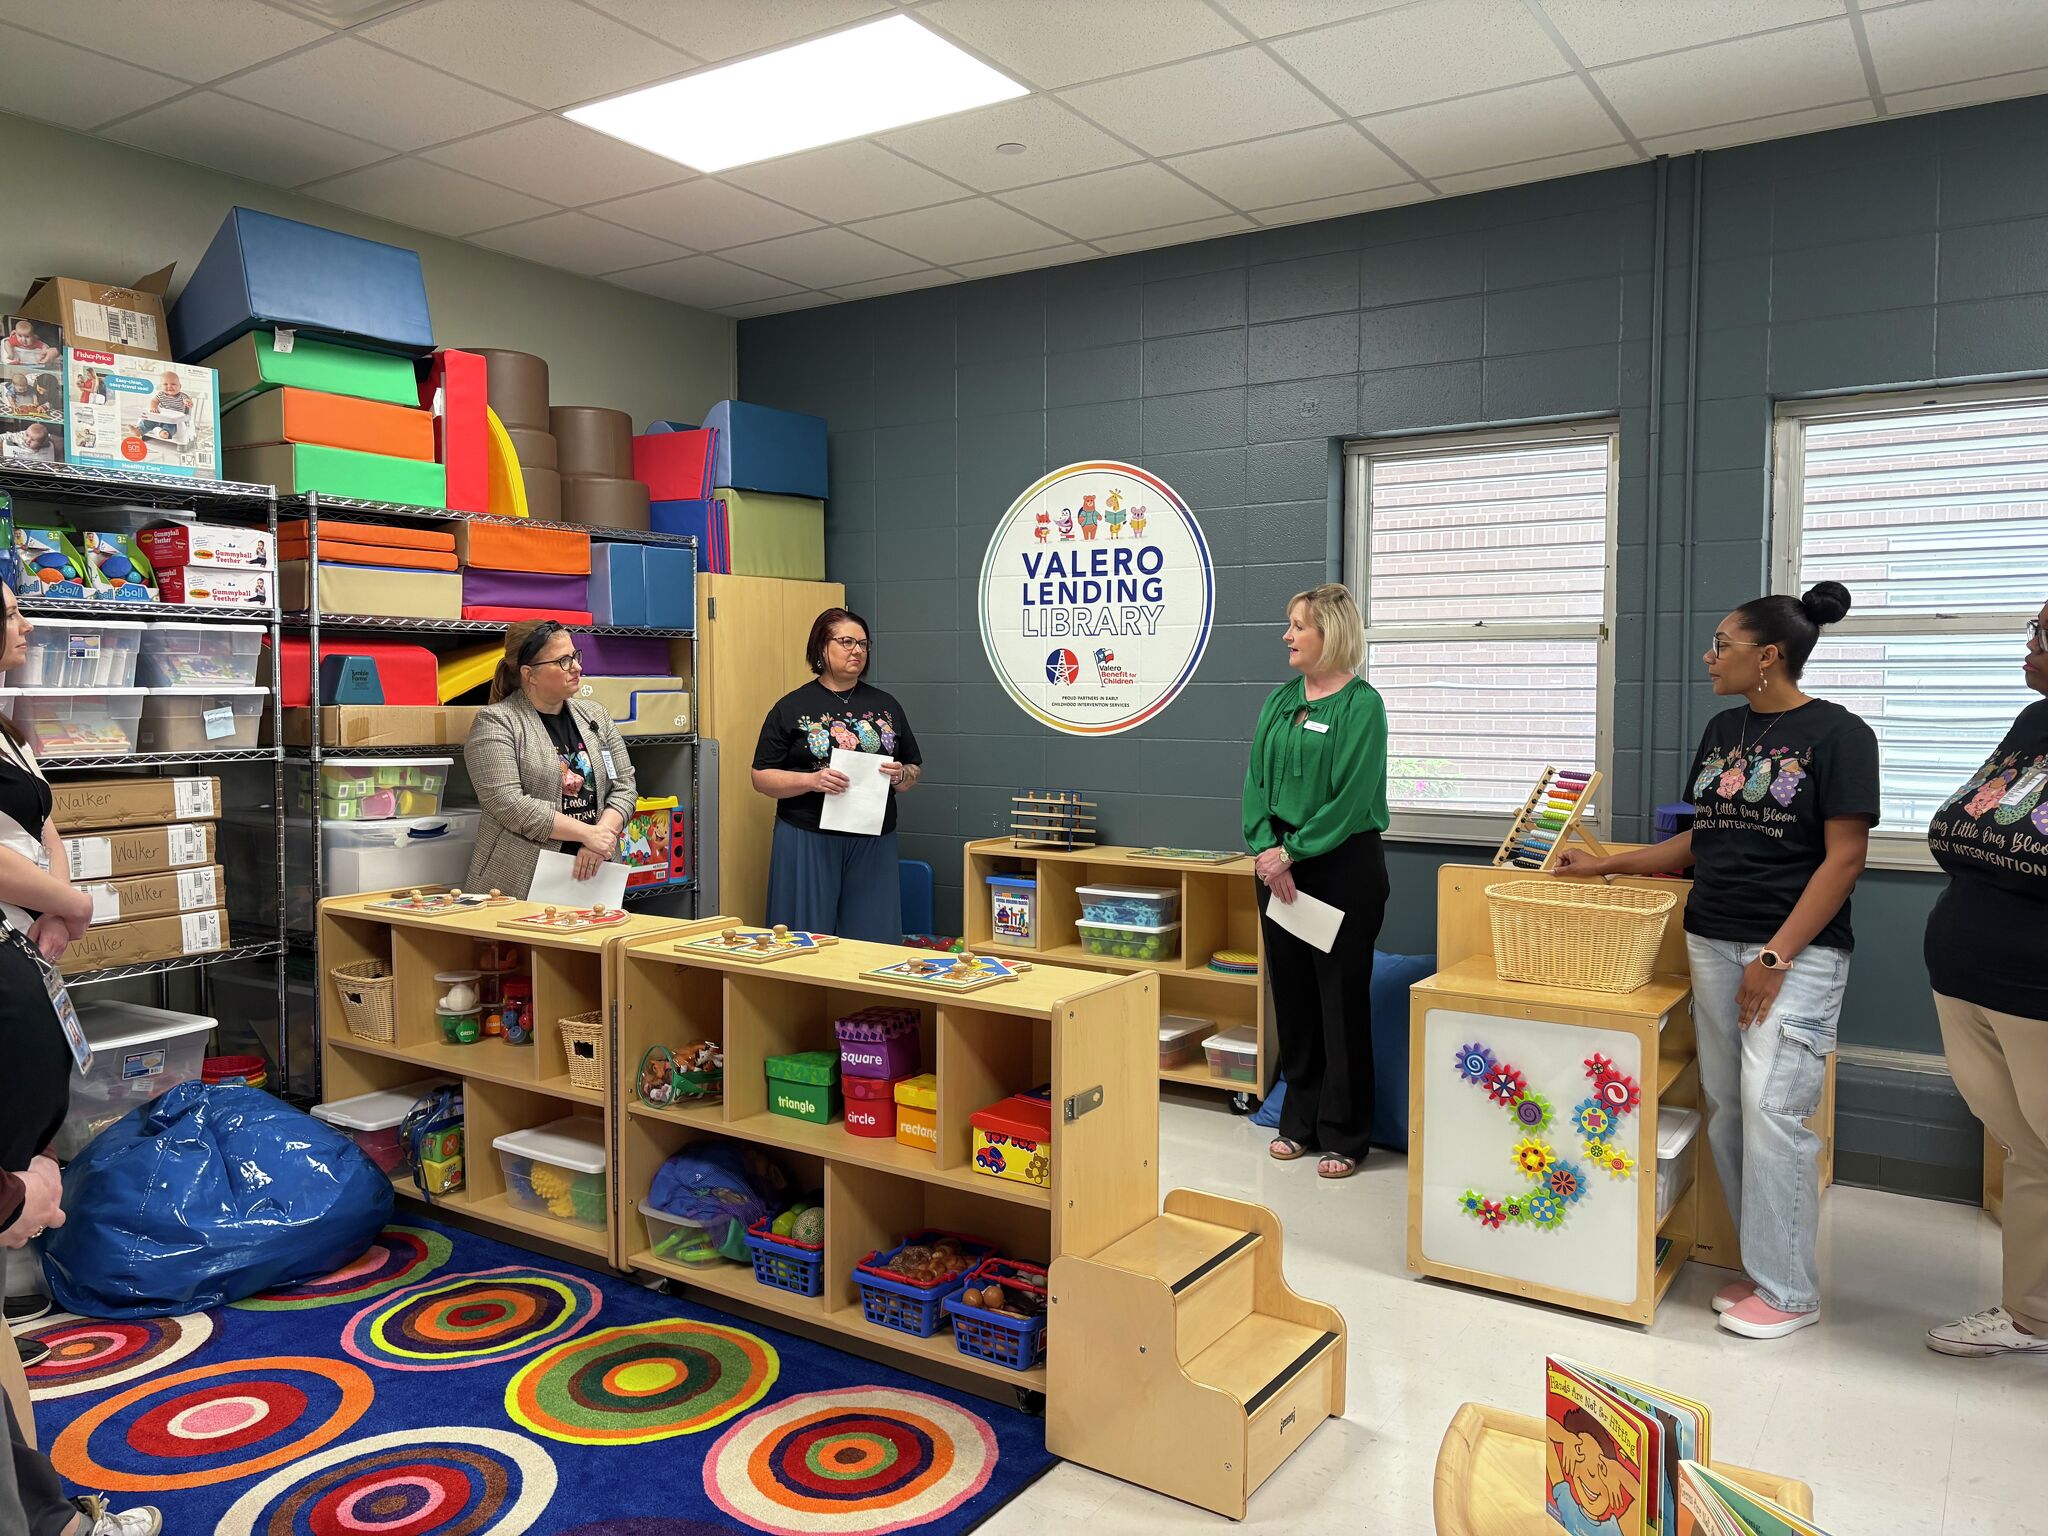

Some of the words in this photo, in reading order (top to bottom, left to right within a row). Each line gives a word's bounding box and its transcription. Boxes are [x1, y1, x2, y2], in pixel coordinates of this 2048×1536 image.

[76, 350, 113, 362] Fisher-Price
[215, 549, 253, 559] Gummyball
[215, 556, 242, 564] Teether
[1022, 545, 1164, 580] VALERO
[212, 588, 251, 597] Gummyball
[1023, 577, 1163, 606] LENDING
[1022, 605, 1166, 637] LIBRARY
[54, 792, 112, 811] Walker
[1715, 801, 1738, 816] Little
[1740, 804, 1759, 820] Ones
[1762, 806, 1798, 823] Bloom
[1719, 819, 1784, 838] INTERVENTION
[1951, 819, 1979, 839] Little
[1983, 826, 2006, 849] Ones
[114, 841, 160, 863] Walker
[1952, 842, 2048, 877] INTERVENTION
[120, 886, 167, 907] Walker
[70, 936, 126, 958] Walker
[841, 1051, 883, 1066] square
[777, 1095, 816, 1114] triangle
[847, 1111, 876, 1126] circle
[1550, 1375, 1571, 1394] Hands
[1571, 1386, 1584, 1403] Are
[1584, 1396, 1598, 1414] Not
[1598, 1406, 1609, 1422] for
[1609, 1414, 1636, 1457] Hitting
